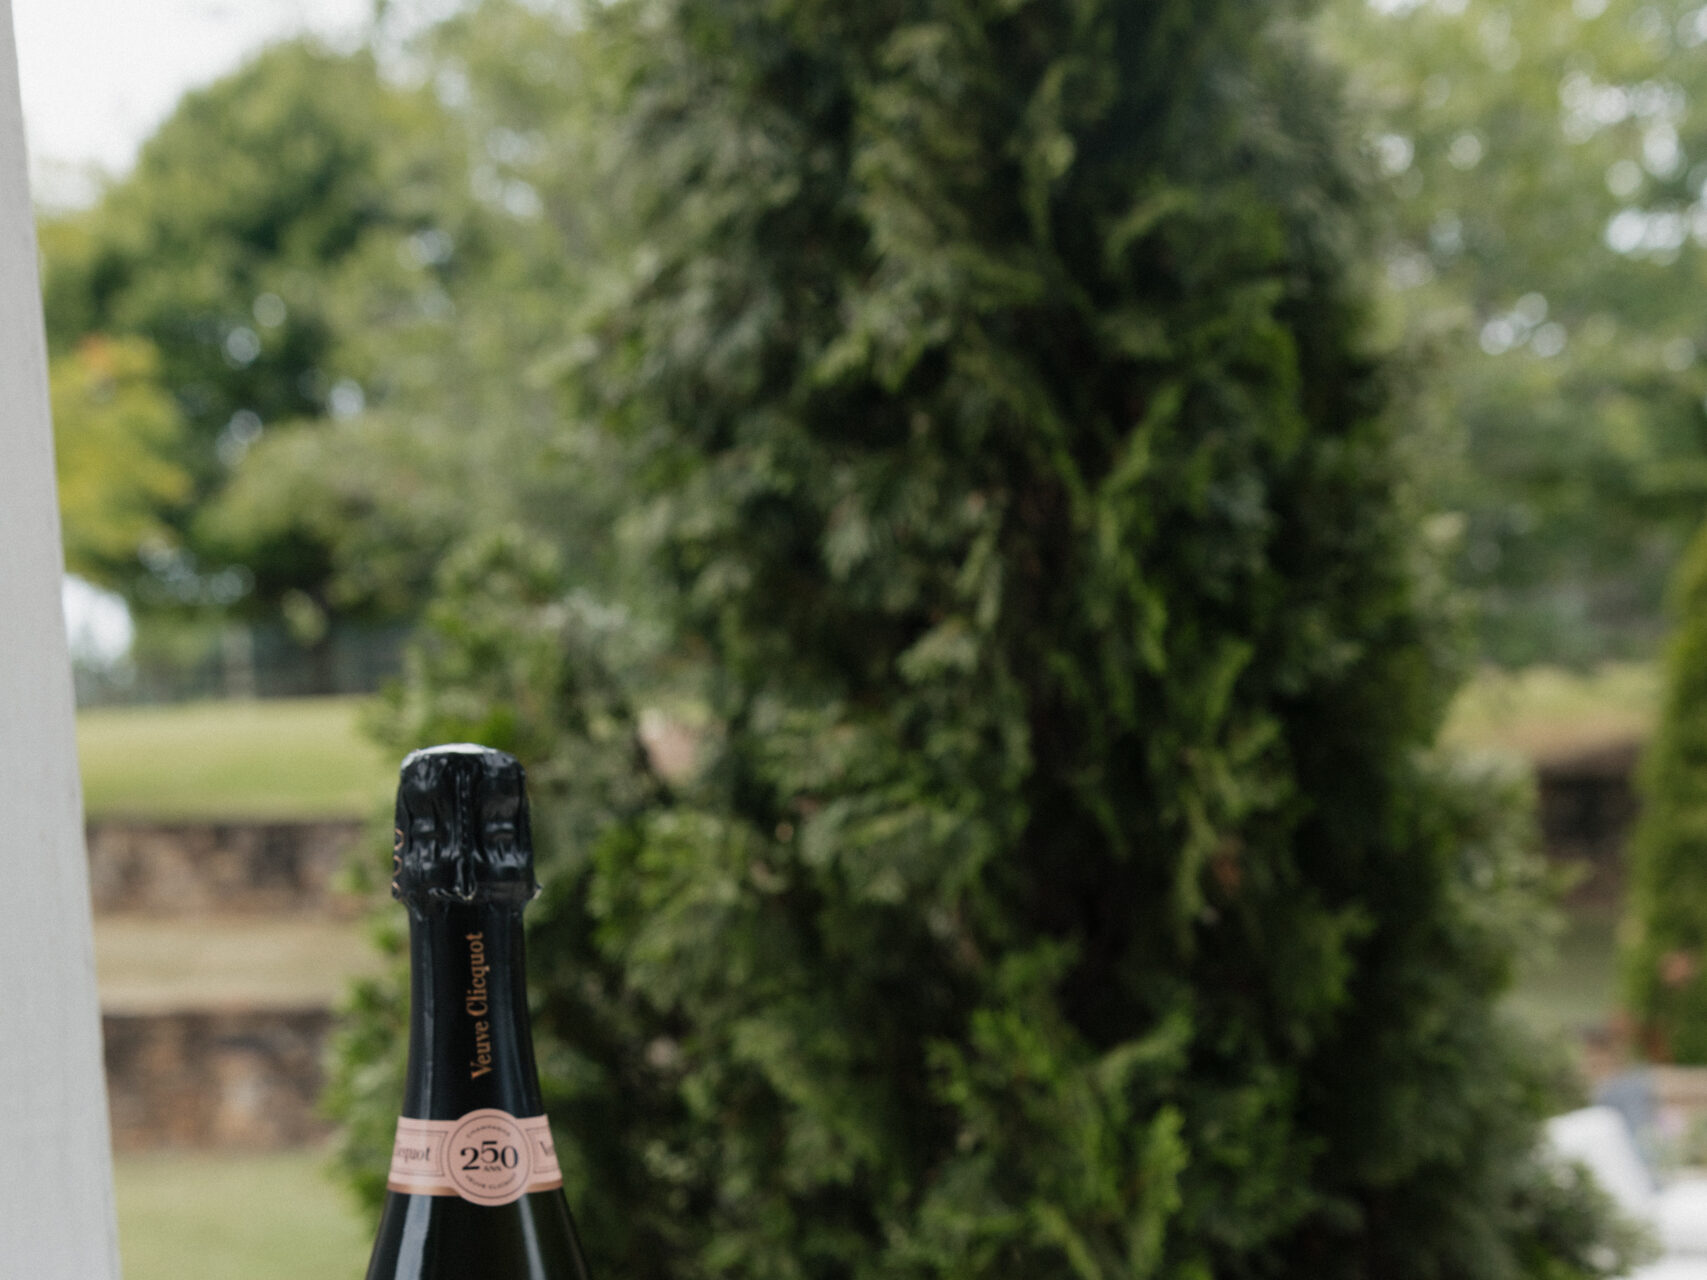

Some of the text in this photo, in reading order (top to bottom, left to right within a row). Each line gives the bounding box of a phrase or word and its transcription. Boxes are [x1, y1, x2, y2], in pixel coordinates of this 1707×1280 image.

[466, 931, 493, 1079] Veuve Clicquot
[460, 1141, 518, 1171] 250
